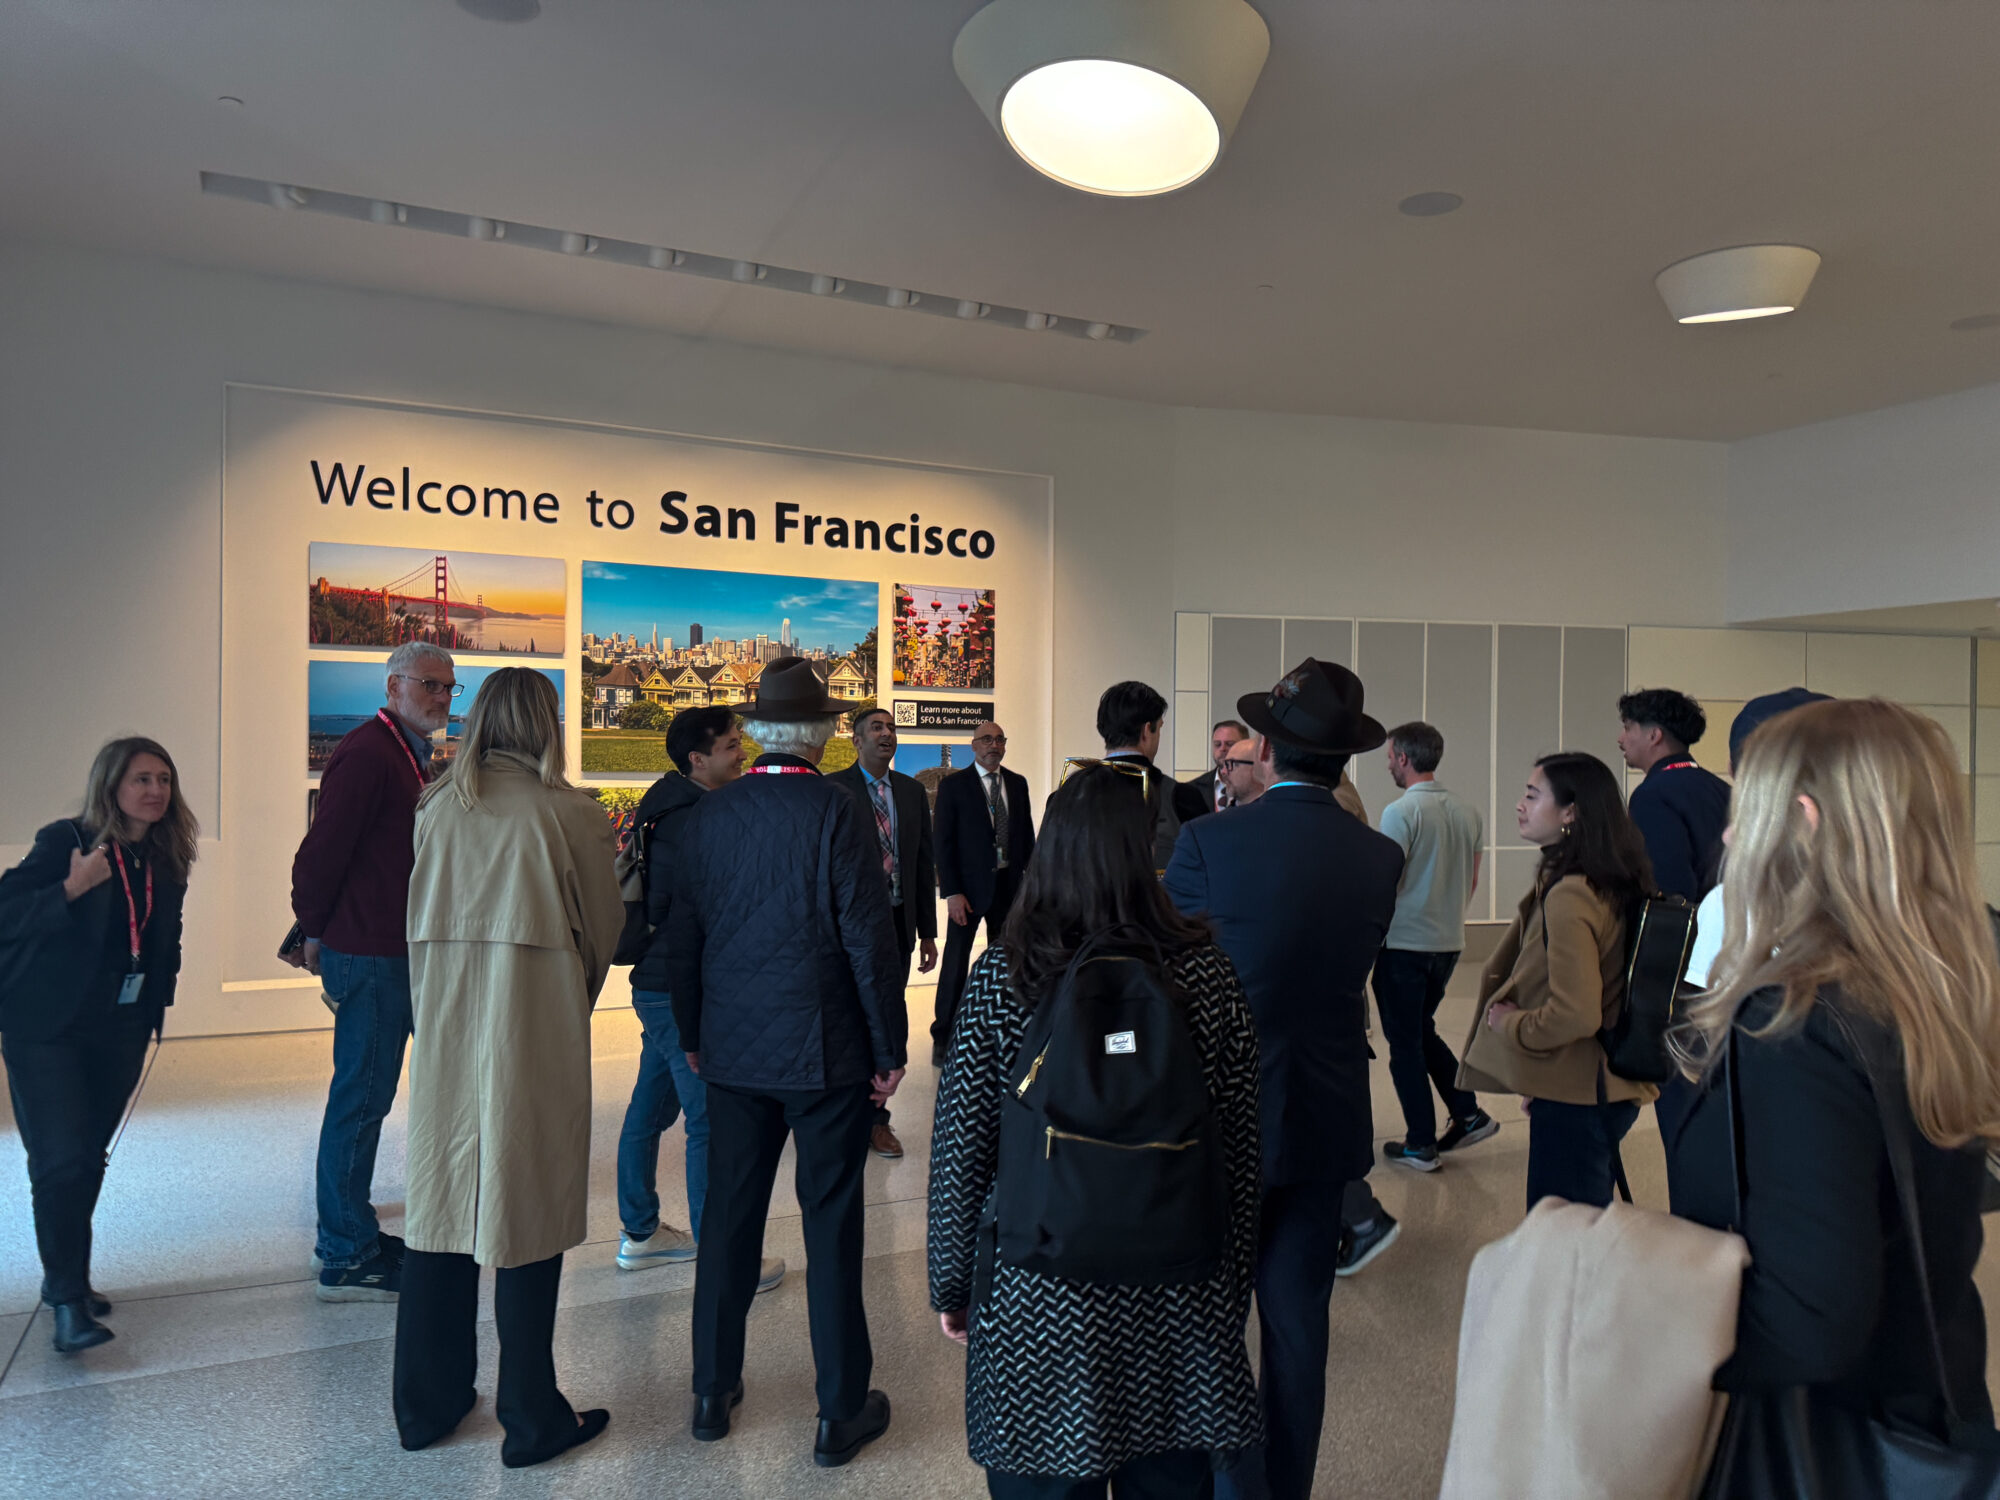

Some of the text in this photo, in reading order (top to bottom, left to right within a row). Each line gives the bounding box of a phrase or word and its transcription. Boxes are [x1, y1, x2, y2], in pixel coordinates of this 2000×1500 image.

[310, 460, 995, 559] Welcome to San Francisco
[920, 705, 940, 713] Learn
[961, 706, 982, 715] about
[920, 716, 935, 724] SFO
[936, 716, 941, 724] &
[943, 716, 956, 725] San
